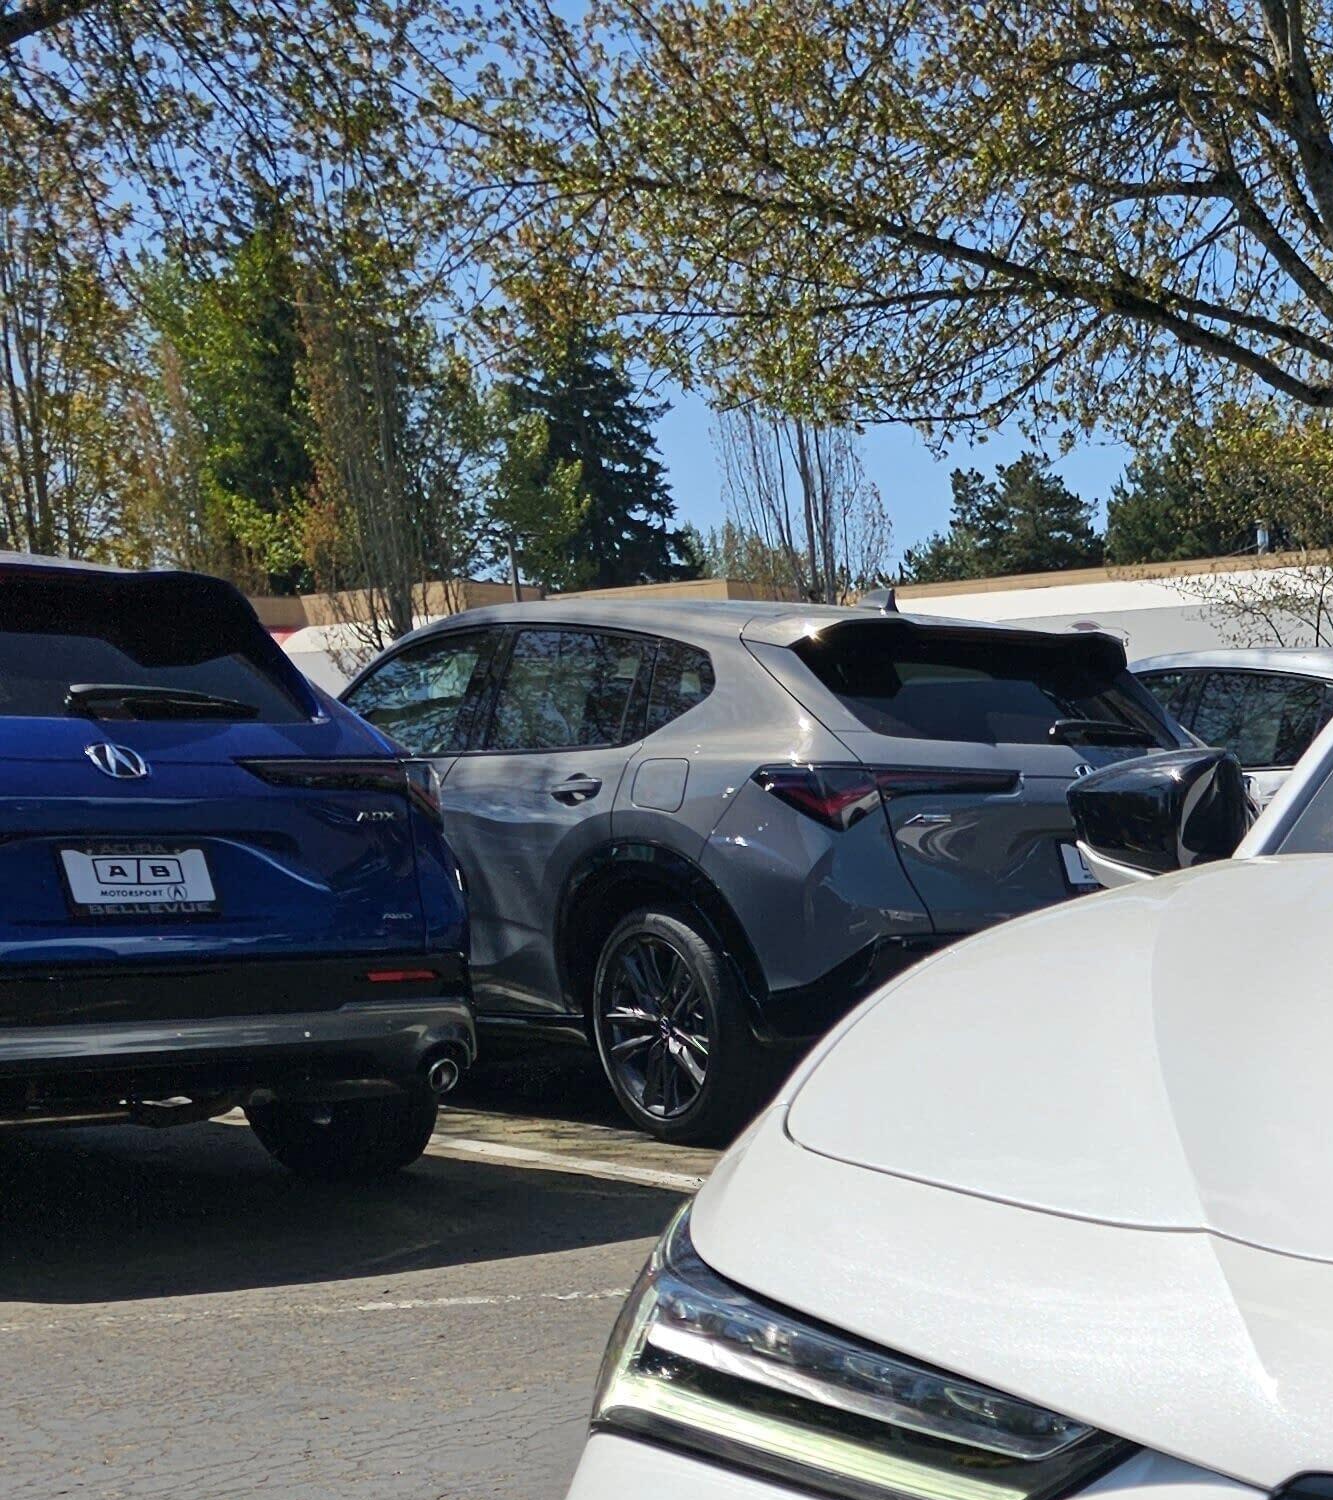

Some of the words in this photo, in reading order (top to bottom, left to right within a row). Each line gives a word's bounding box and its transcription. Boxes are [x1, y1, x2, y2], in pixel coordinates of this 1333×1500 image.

[109, 865, 128, 877] A
[149, 865, 170, 877] B
[100, 889, 163, 897] MOTORSPORT
[88, 902, 212, 914] BELLEVUE
